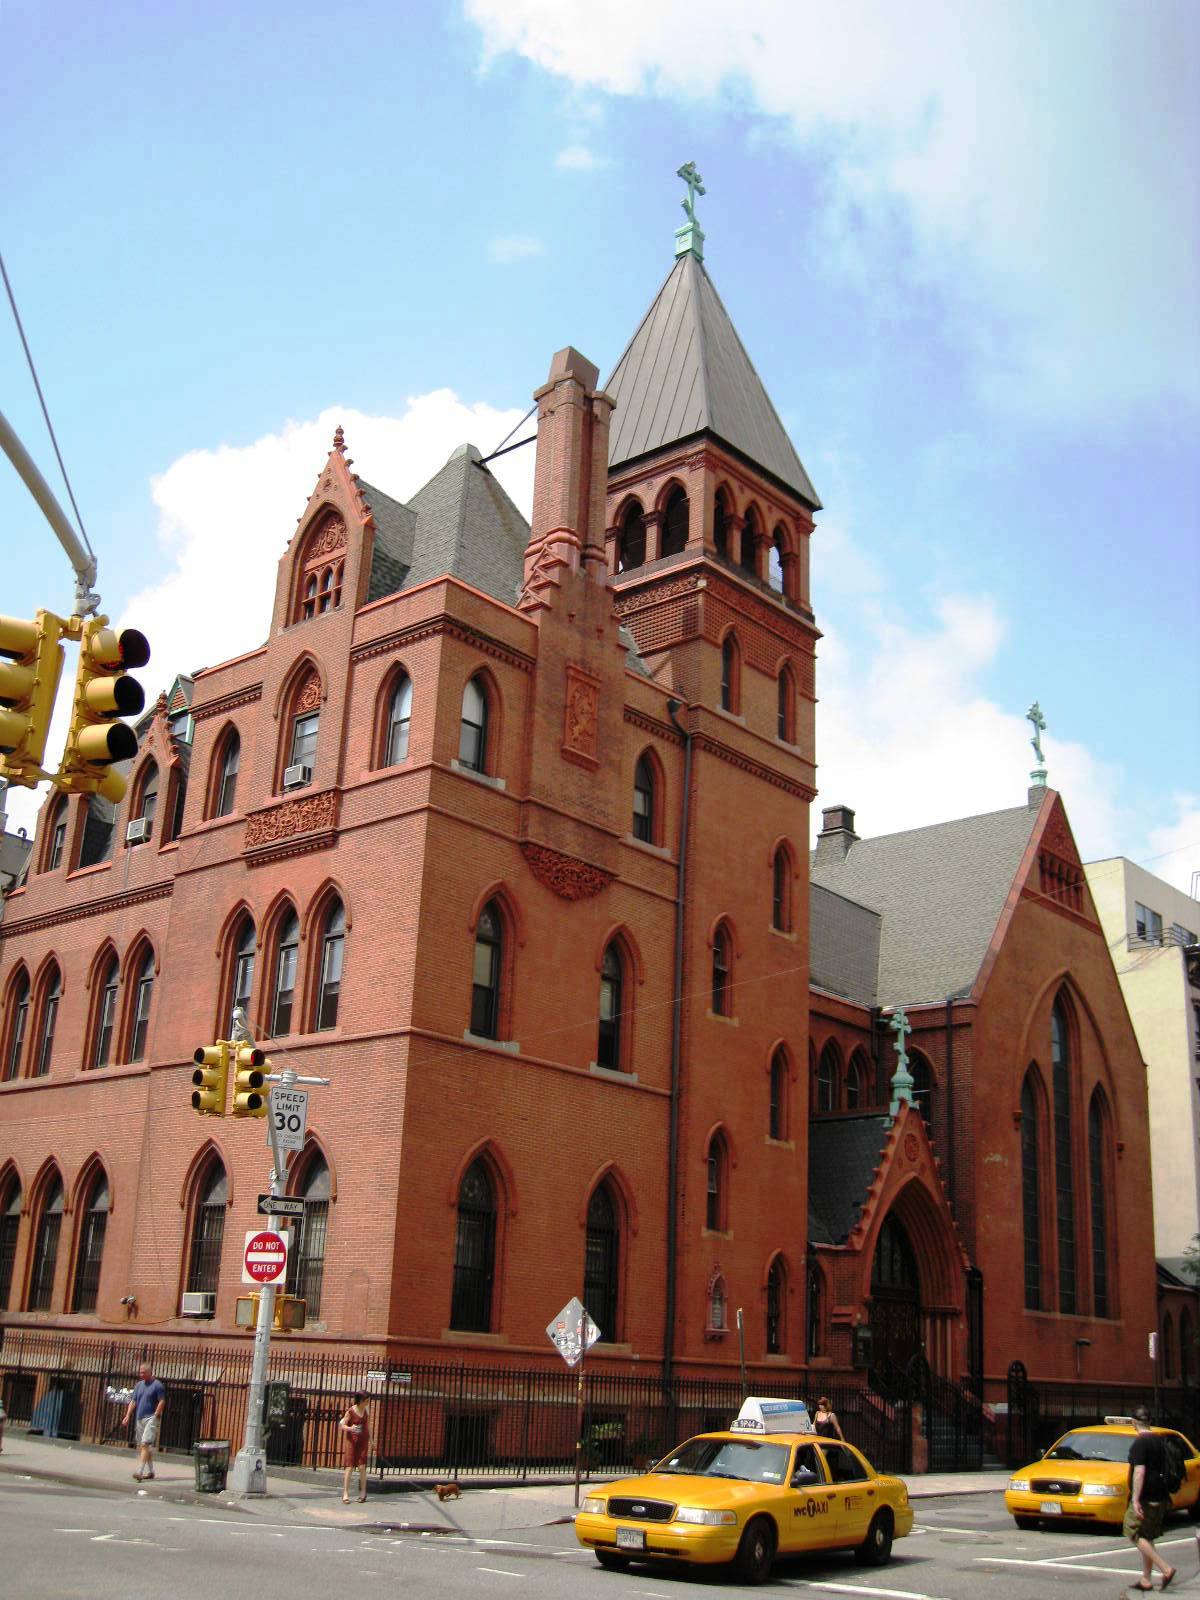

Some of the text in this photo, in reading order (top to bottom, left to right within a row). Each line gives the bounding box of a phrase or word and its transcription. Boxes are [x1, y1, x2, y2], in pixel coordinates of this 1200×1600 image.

[274, 1092, 305, 1102] SPEED
[276, 1103, 301, 1112] LIMIT
[275, 1112, 301, 1132] 30
[264, 1200, 298, 1211] ONE WAY
[252, 1241, 280, 1250] DO NOT
[252, 1263, 277, 1273] ENTER
[794, 1498, 829, 1517] NYC TAXI
